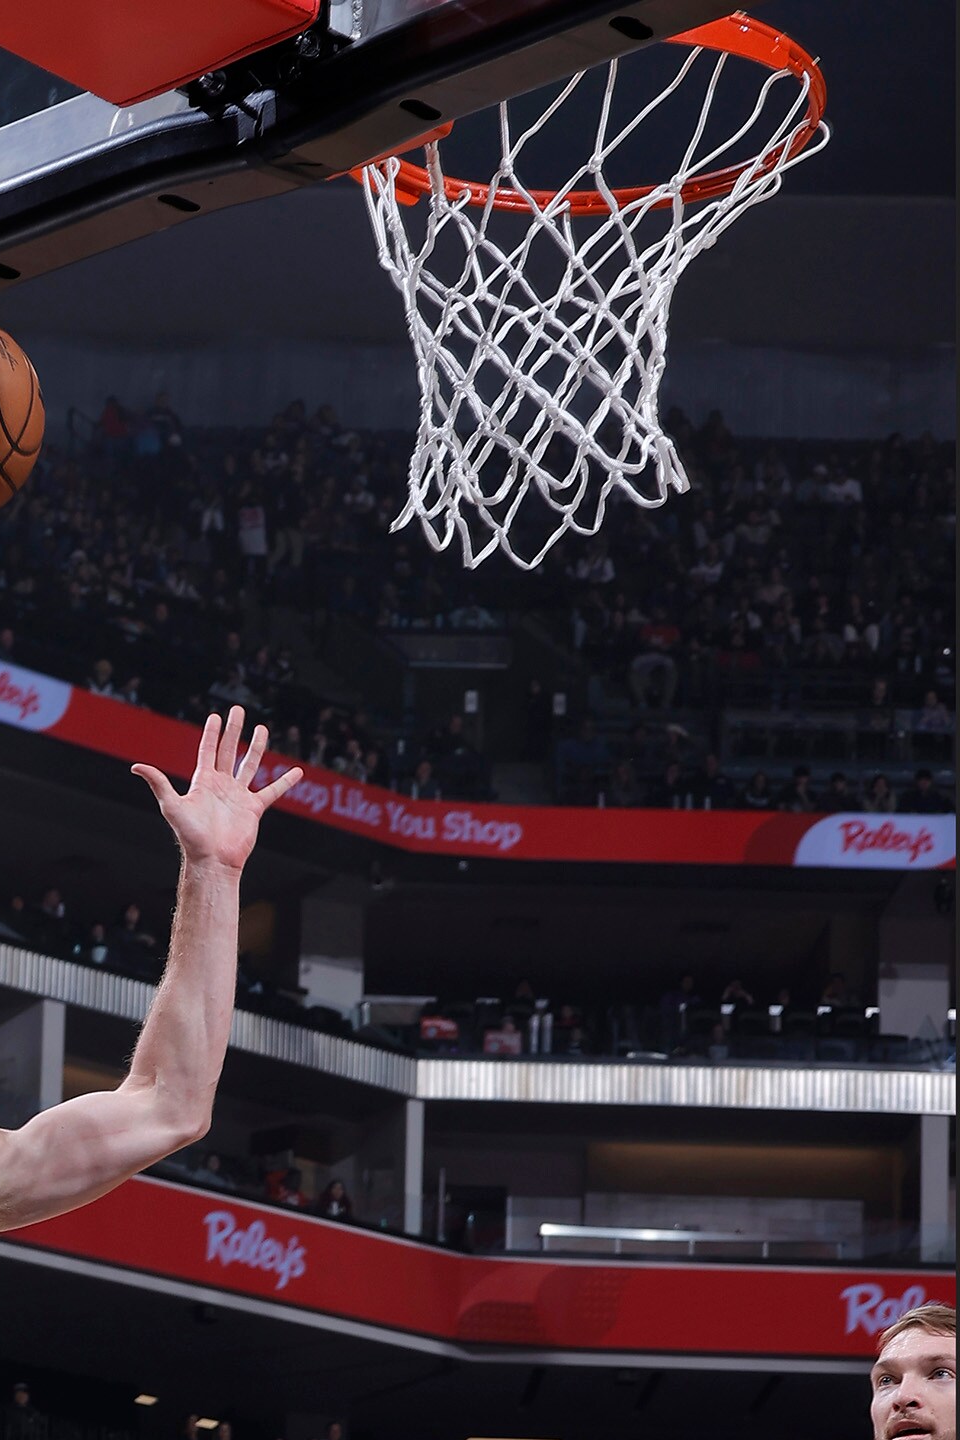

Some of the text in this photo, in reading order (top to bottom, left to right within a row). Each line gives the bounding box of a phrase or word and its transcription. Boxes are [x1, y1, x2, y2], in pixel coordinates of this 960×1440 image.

[331, 784, 382, 826] Like
[386, 800, 436, 839] You
[442, 810, 523, 850] Shop
[838, 818, 934, 863] Raley's
[203, 1210, 308, 1290] Raley's
[840, 1282, 926, 1336] Ral
